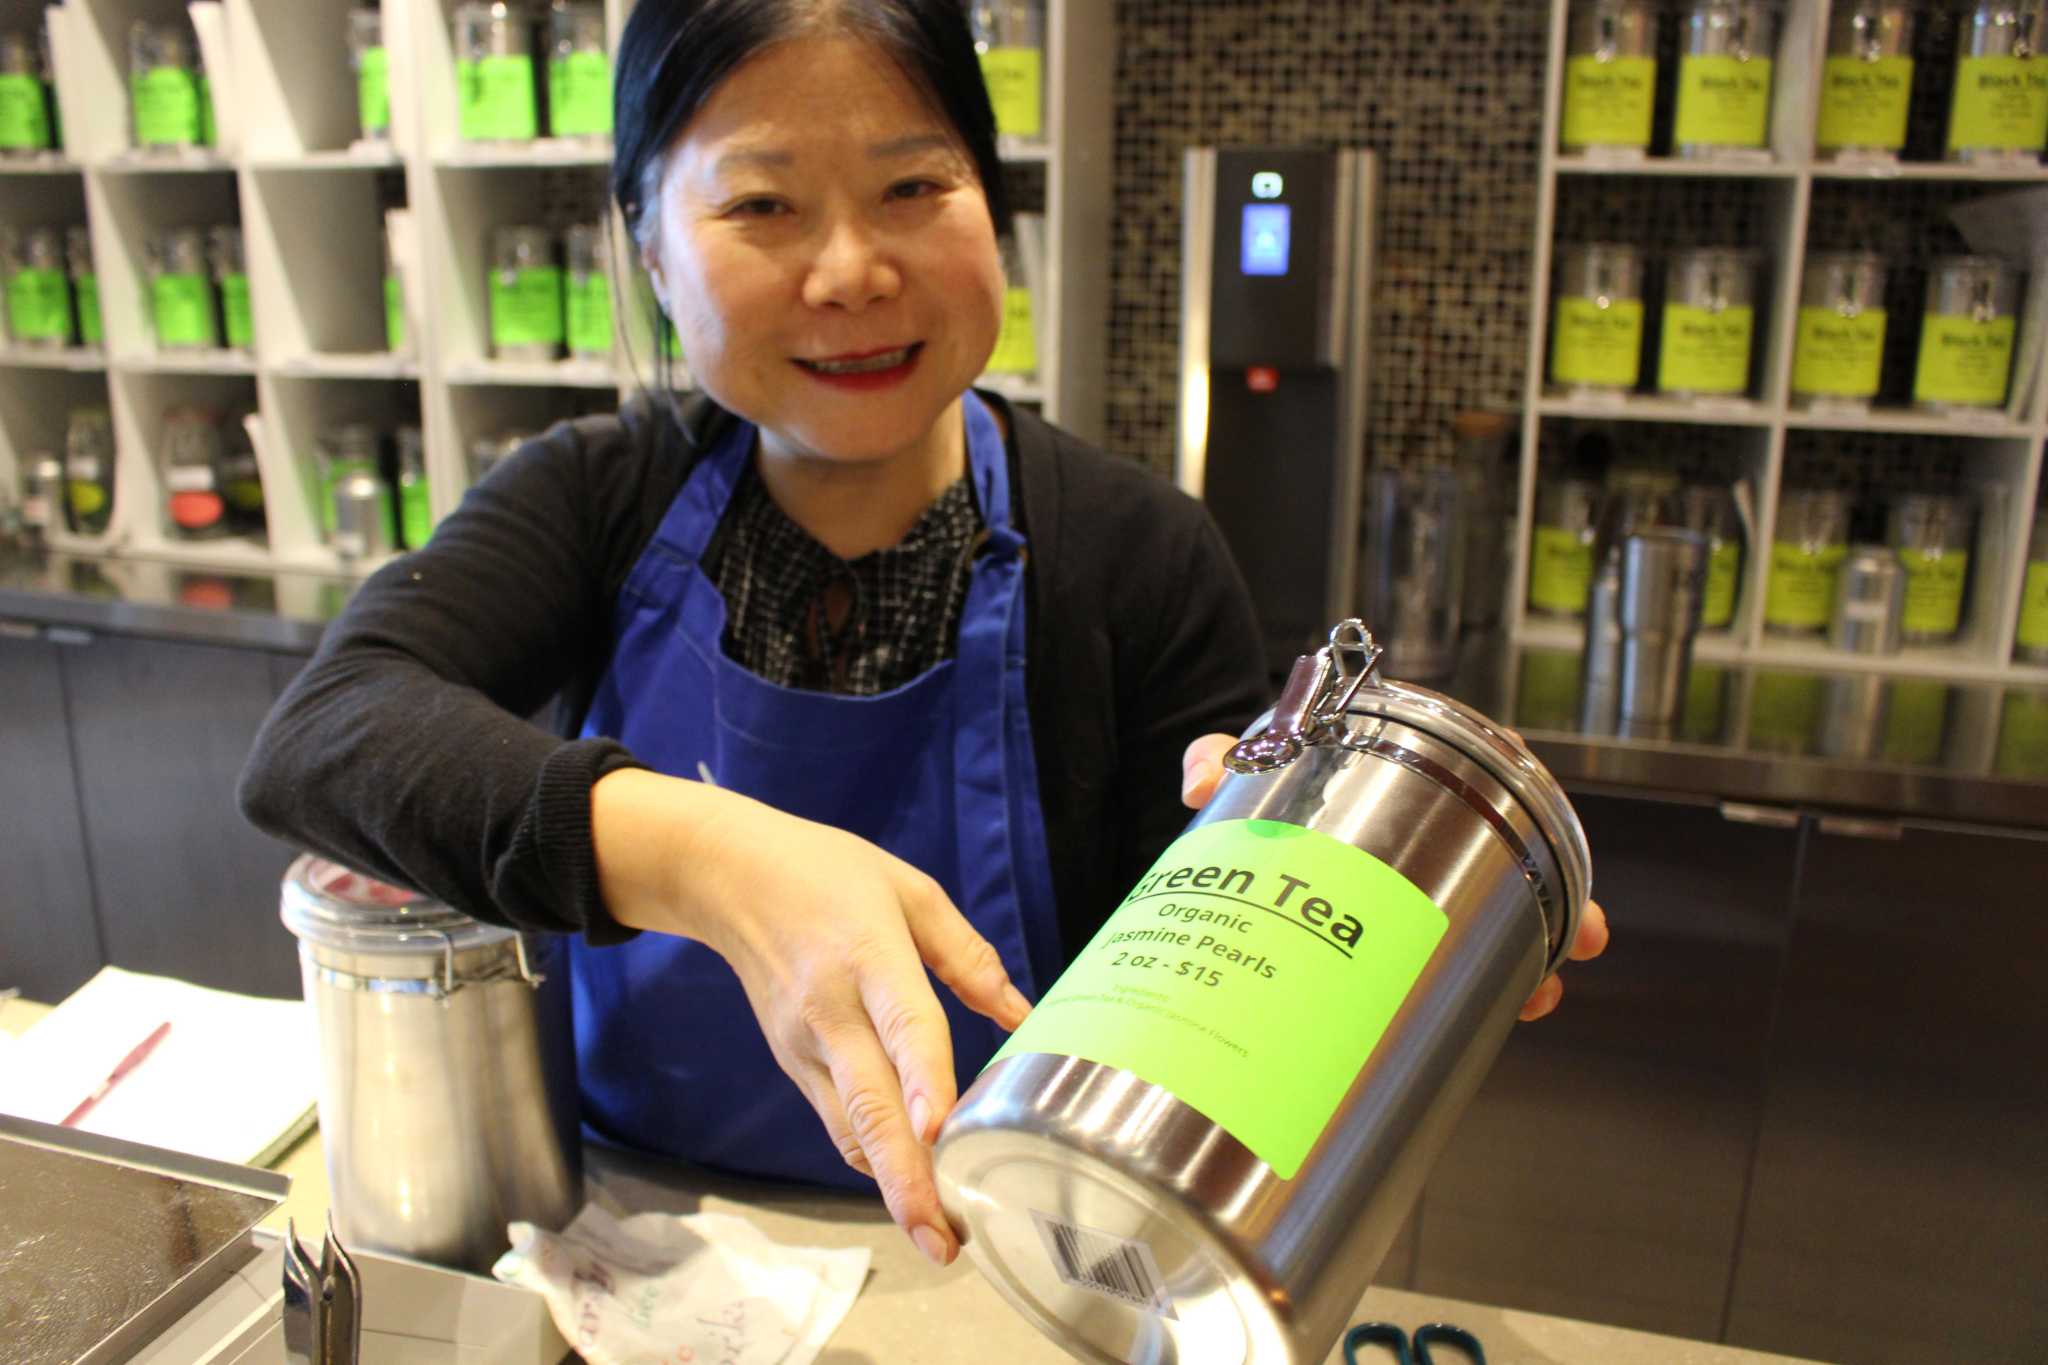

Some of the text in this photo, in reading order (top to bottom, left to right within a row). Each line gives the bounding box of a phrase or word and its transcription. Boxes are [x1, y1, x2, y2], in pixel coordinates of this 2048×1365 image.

[1158, 903, 1253, 933] Organic
[1274, 873, 1364, 949] Tea
[1100, 927, 1277, 979] Jasmine Pearls
[1111, 952, 1129, 966] 2
[1130, 955, 1158, 968] oz
[1175, 961, 1223, 987] $15
